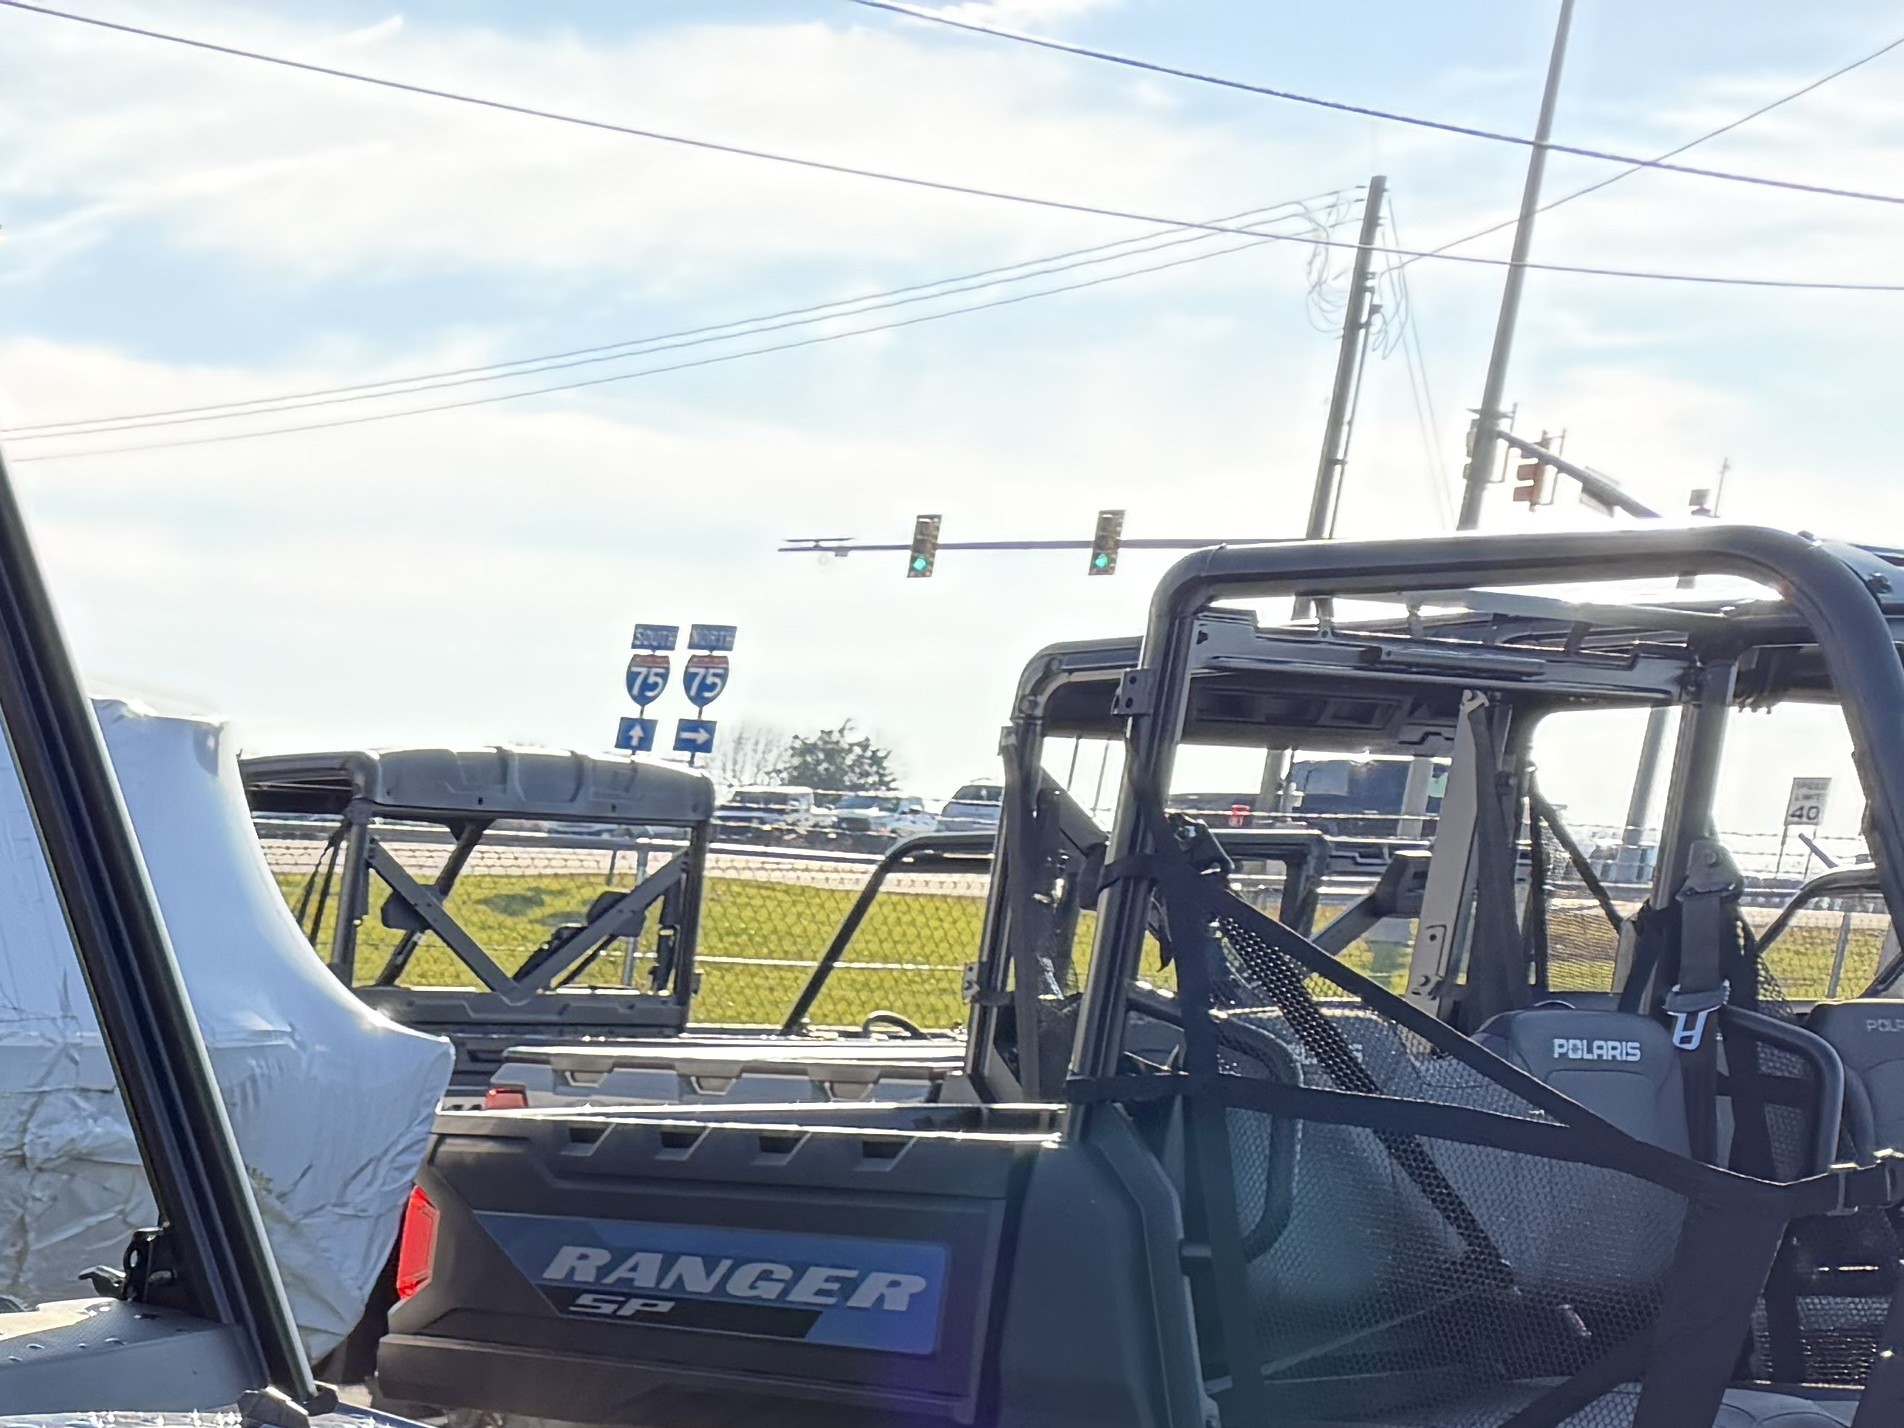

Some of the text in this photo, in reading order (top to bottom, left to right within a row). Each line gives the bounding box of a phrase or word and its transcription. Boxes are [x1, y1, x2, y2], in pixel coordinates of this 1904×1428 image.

[634, 628, 675, 646] SOUTH
[691, 628, 735, 647] NORTH
[630, 667, 666, 697] 75
[687, 667, 725, 697] 75
[1790, 805, 1820, 820] 40
[1553, 1038, 1641, 1061] POLARIS
[543, 1245, 927, 1312] RANGER
[570, 1293, 676, 1317] SP
